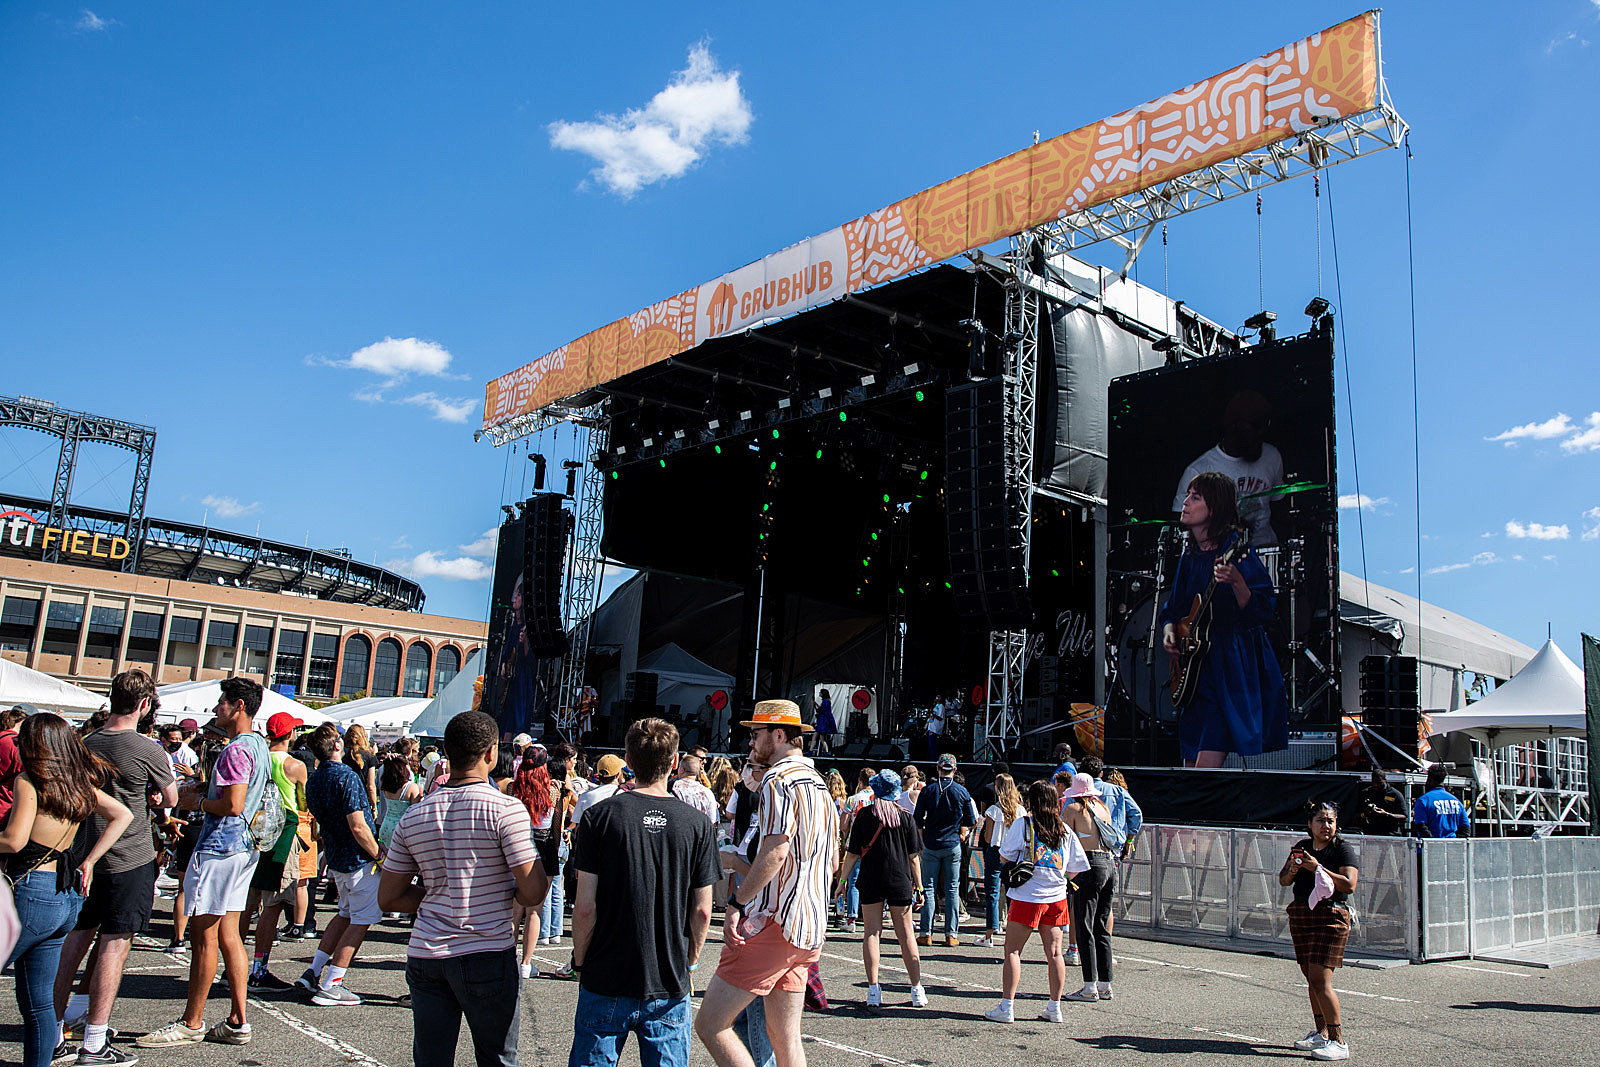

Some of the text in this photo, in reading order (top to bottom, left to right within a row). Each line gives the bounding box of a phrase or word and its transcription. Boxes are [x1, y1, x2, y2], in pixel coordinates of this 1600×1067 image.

[741, 261, 832, 319] GRUBHUB
[0, 517, 130, 559] iti FIELD
[1056, 610, 1094, 657] We
[1433, 800, 1460, 815] STAFF
